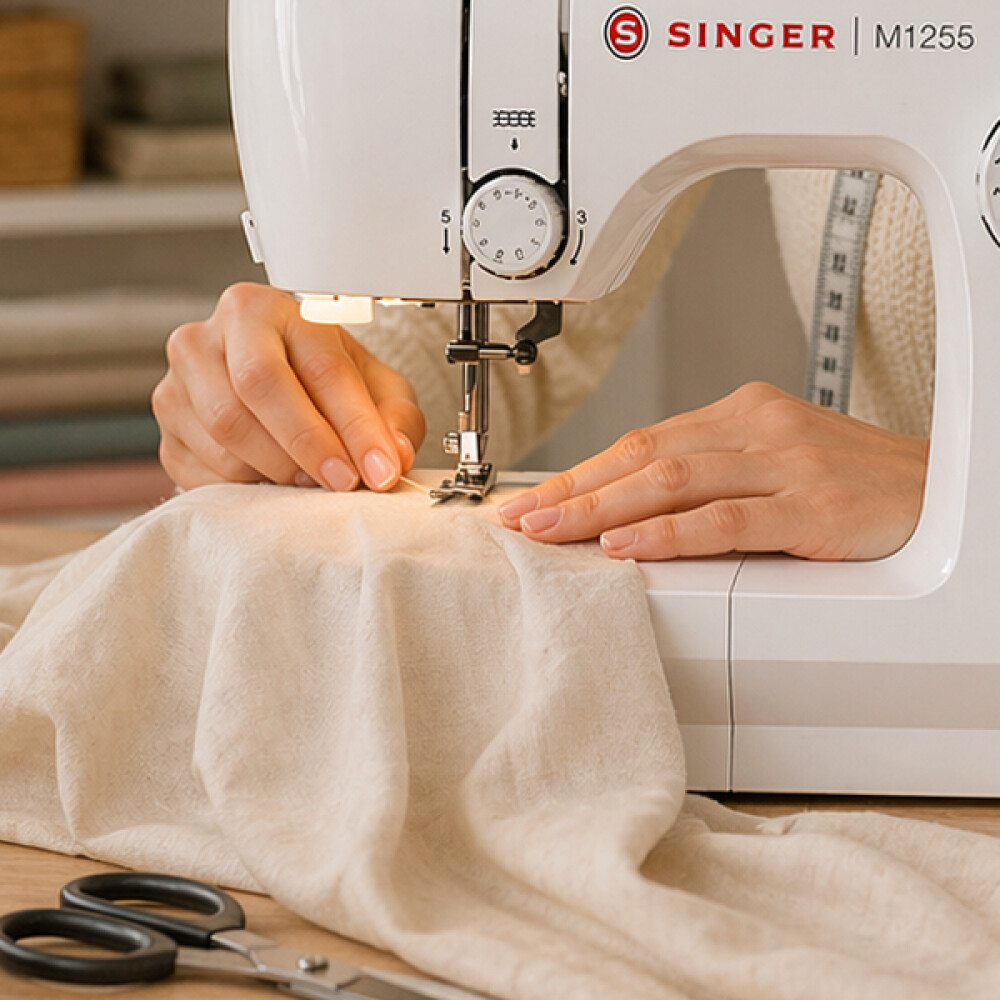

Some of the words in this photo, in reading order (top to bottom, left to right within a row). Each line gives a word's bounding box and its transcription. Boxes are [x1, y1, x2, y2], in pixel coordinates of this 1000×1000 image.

[615, 20, 637, 46] S
[667, 21, 836, 49] SINGER
[875, 24, 975, 50] M1255
[440, 209, 452, 225] 5
[576, 209, 588, 226] 3
